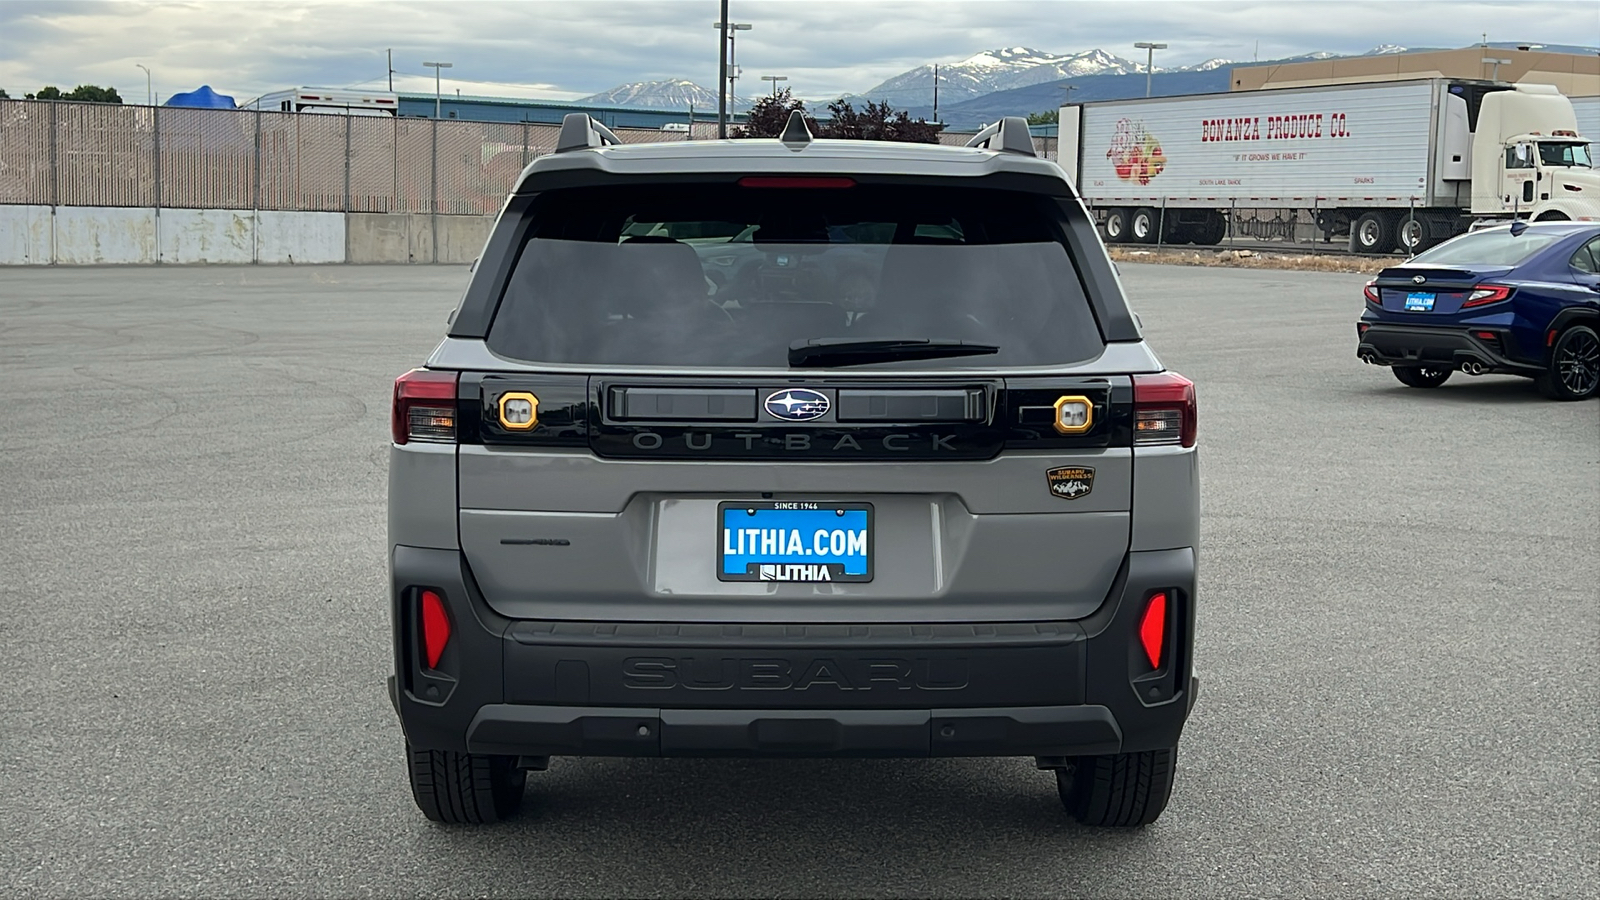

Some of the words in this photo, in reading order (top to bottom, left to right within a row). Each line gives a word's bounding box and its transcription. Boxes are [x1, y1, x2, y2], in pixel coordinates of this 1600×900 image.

[1202, 118, 1260, 142] BONANZA
[1267, 114, 1322, 139] PRODUCE
[1331, 113, 1350, 137] CO.
[1249, 153, 1270, 161] GROWS
[1272, 153, 1281, 161] WE
[1282, 152, 1298, 160] HAVE
[632, 432, 958, 451] OUTBACK
[774, 502, 798, 510] SINCE
[724, 528, 868, 557] LITHIA.COM
[775, 564, 832, 581] LITHIA
[622, 656, 970, 691] SUBARU
